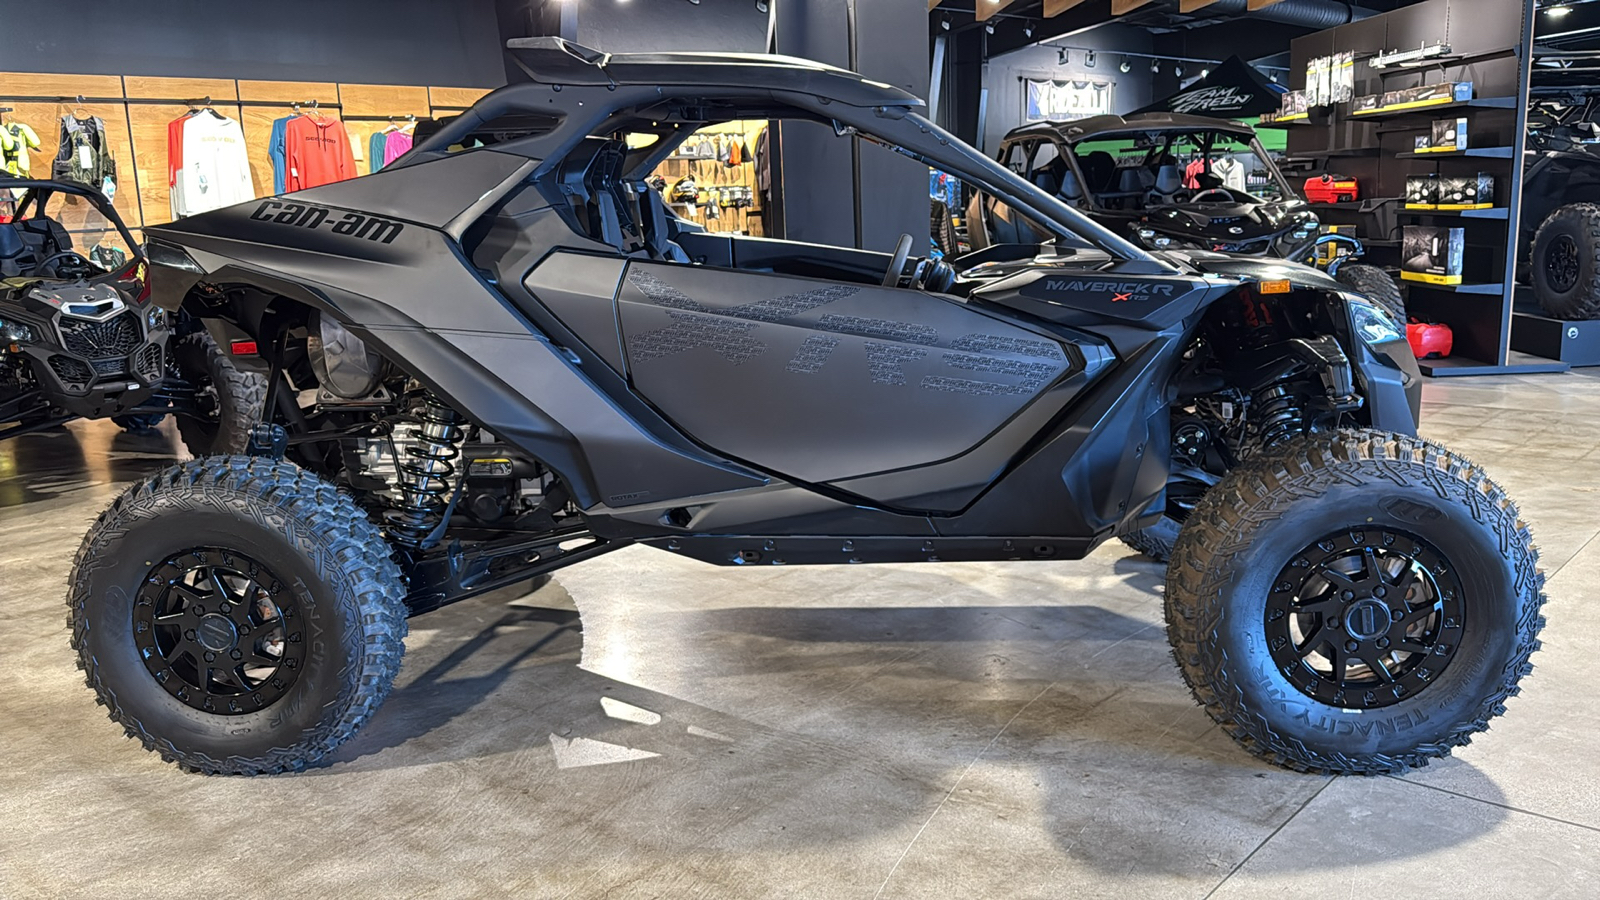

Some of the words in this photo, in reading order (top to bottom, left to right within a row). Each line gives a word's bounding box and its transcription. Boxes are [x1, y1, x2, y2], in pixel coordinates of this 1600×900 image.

[1173, 94, 1252, 113] GREEN
[1045, 280, 1152, 294] MAVERICK
[1152, 284, 1174, 296] R
[1293, 708, 1430, 737] TENACITY
